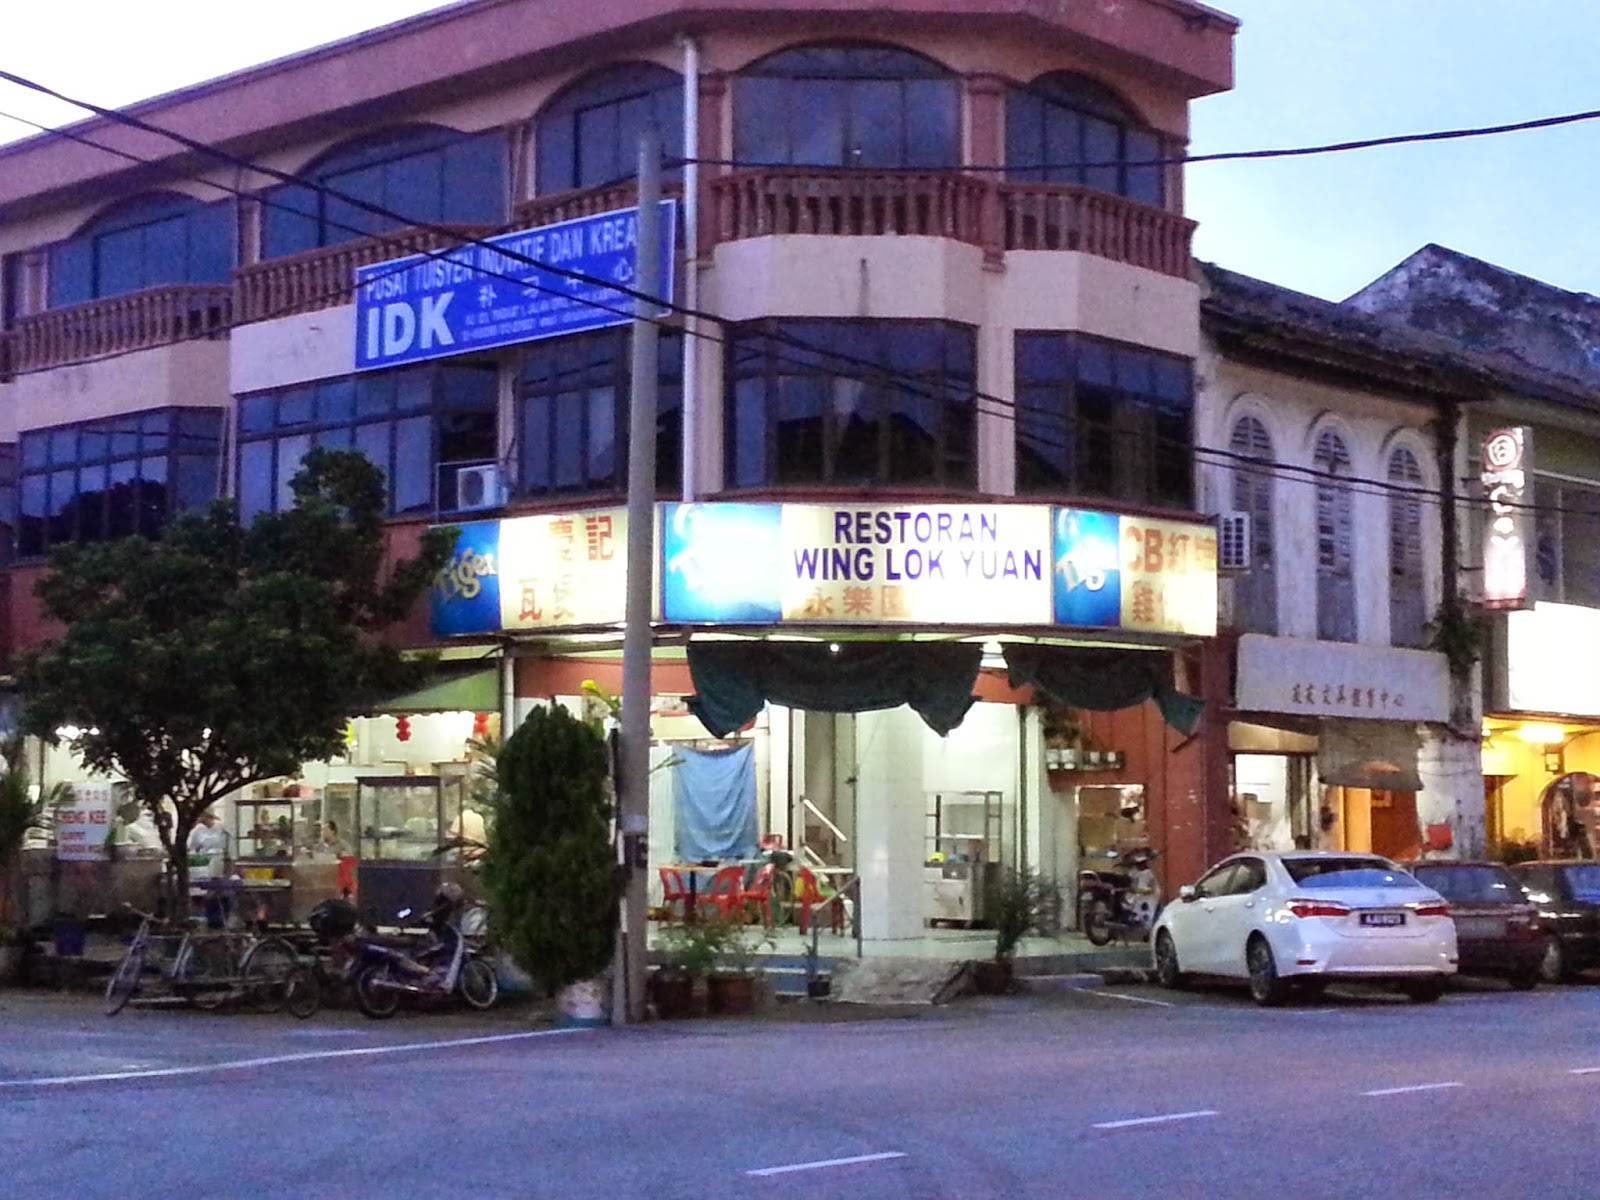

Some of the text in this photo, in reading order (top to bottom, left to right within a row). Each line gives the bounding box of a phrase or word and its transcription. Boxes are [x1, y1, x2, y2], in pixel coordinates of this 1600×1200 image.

[551, 228, 583, 263] DAN
[590, 216, 638, 256] KREA
[366, 291, 455, 360] IDK
[833, 510, 998, 545] RESTORAN
[793, 548, 875, 581] WING
[885, 548, 946, 581] LOK
[961, 548, 1043, 581] YUAN
